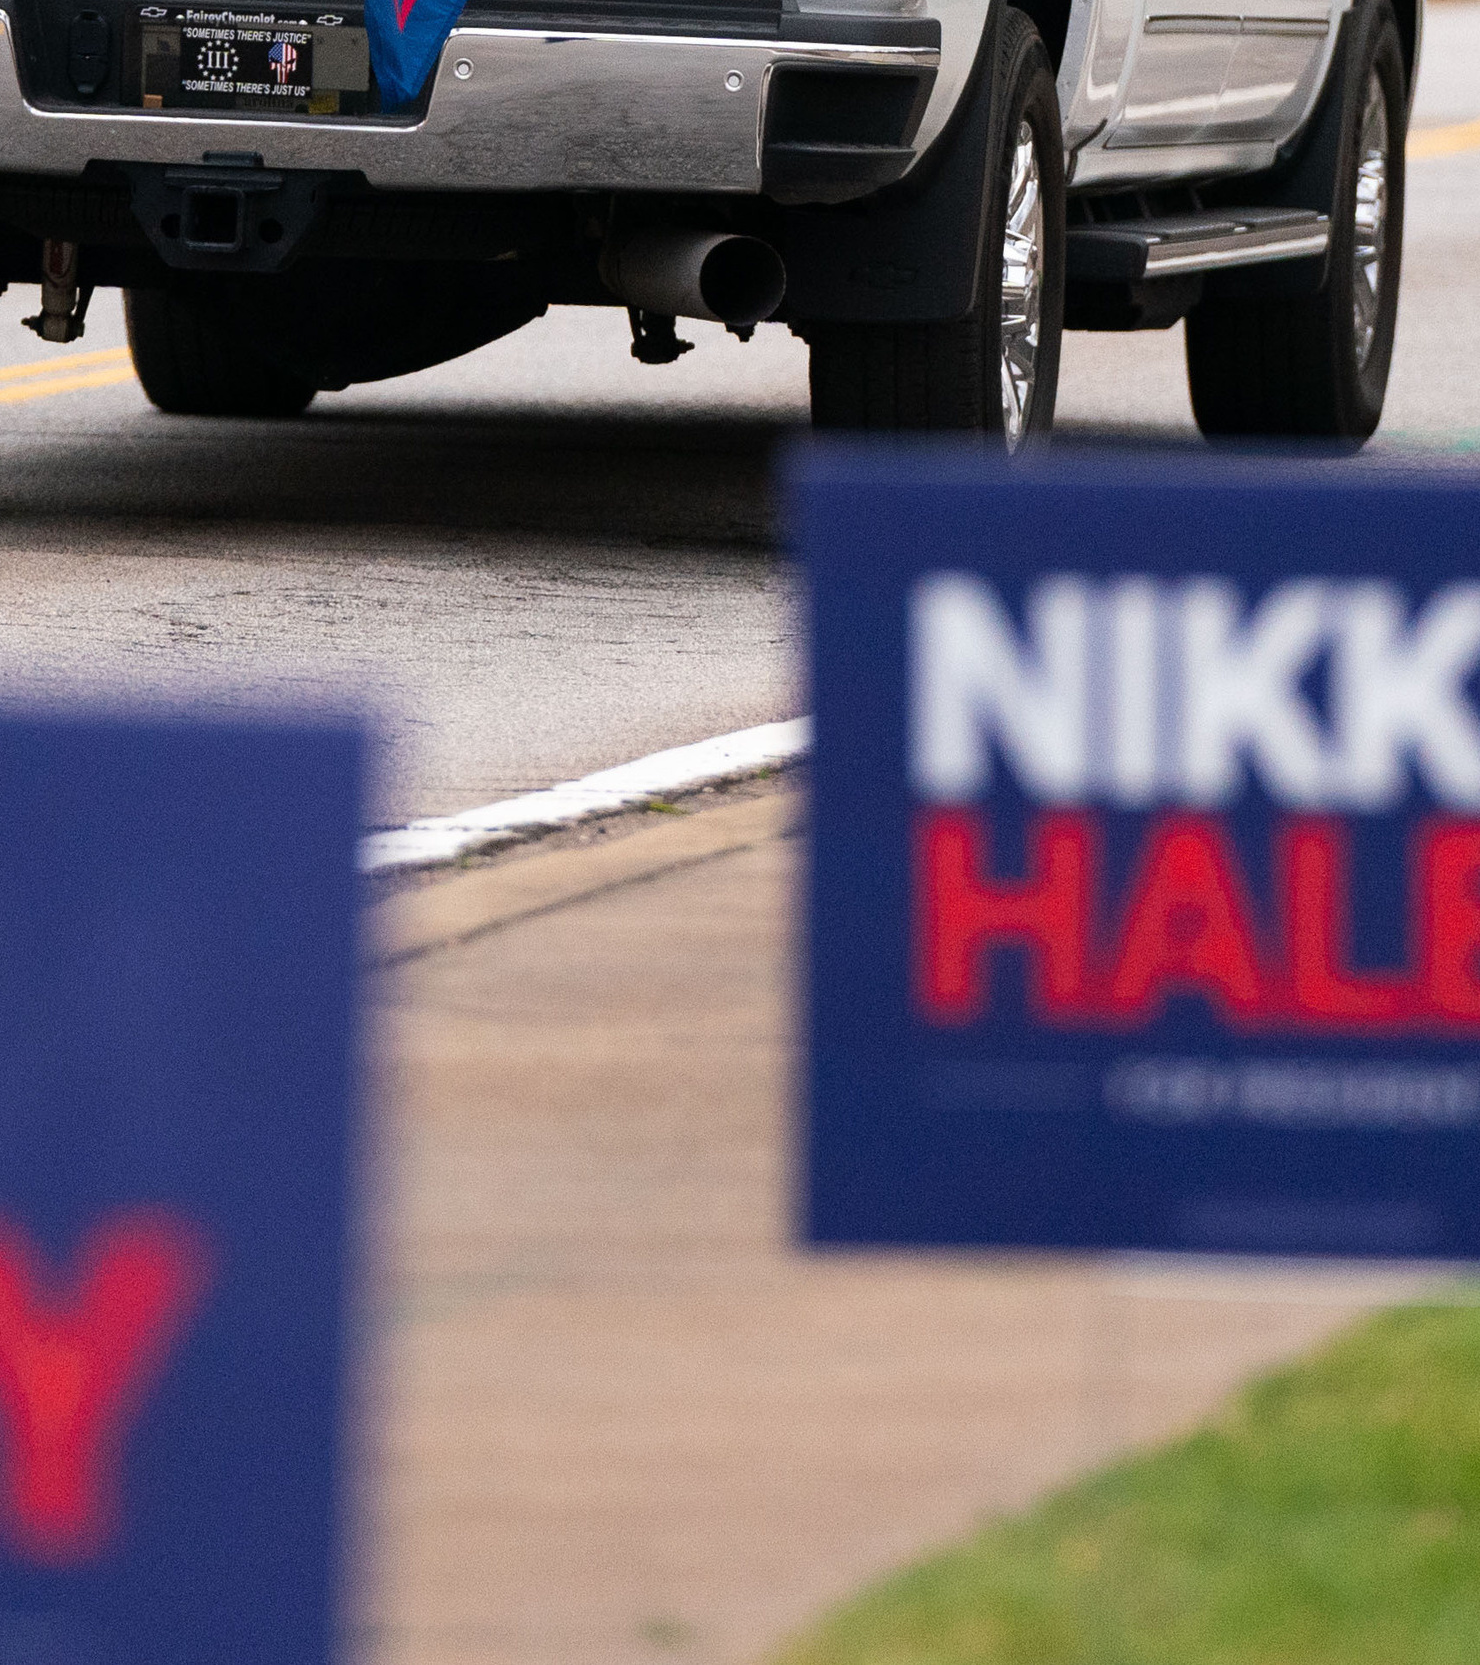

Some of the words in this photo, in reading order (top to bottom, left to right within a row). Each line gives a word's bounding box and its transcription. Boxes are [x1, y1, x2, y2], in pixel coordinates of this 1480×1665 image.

[237, 30, 271, 42] THERE'S
[236, 82, 270, 94] THERE'S
[272, 84, 293, 96] JUST
